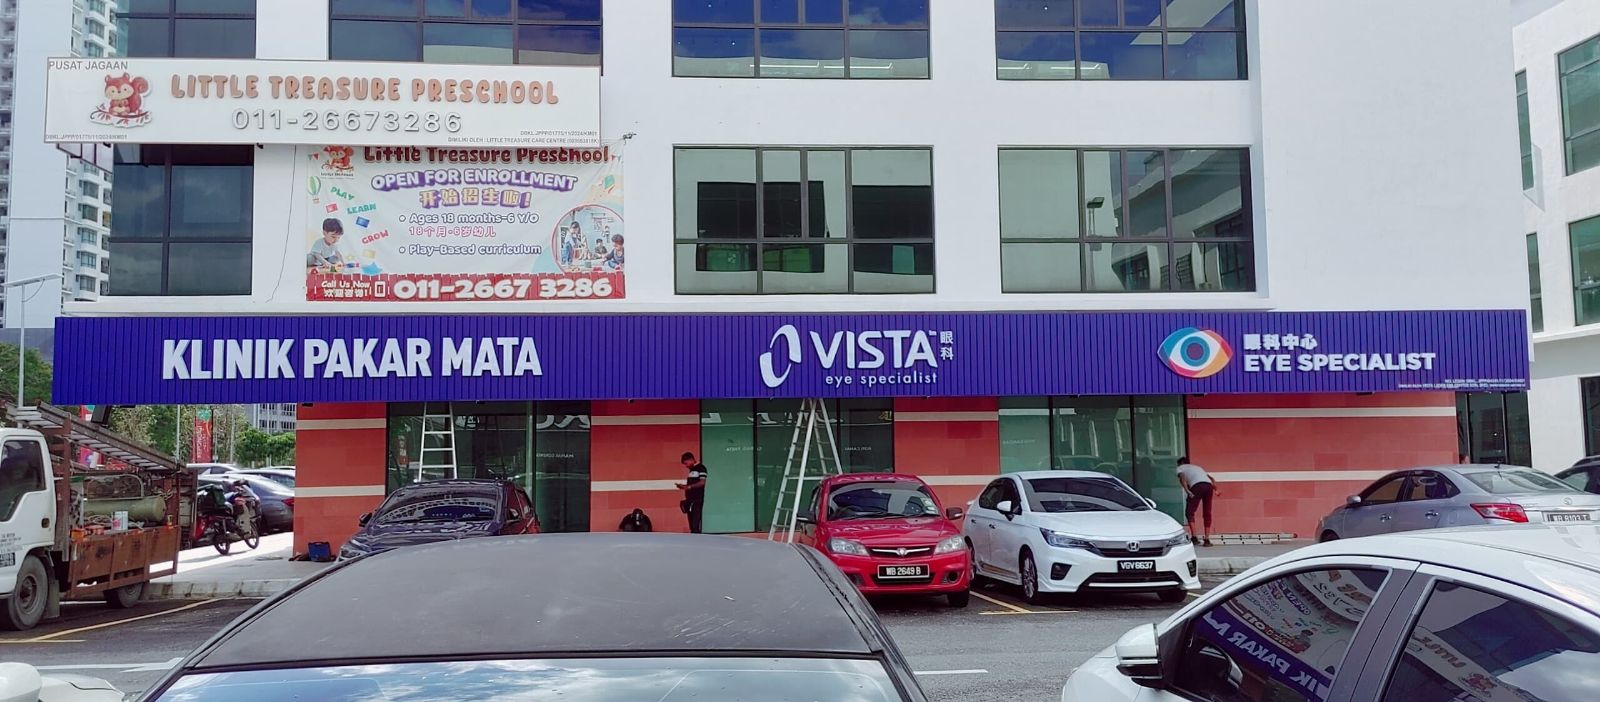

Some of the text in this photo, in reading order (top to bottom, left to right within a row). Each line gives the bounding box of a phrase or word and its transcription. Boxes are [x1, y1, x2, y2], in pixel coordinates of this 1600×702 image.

[49, 61, 128, 70] PUSAT JAGAAN
[171, 74, 559, 105] LITTLE TREASURE PRESCHOOL
[232, 107, 463, 133] 011-26673286
[364, 146, 609, 163] Little Treasure Preschool
[371, 168, 578, 192] OPEN FOR ENROLLMENT
[330, 186, 355, 201] PLAY
[347, 203, 377, 214] LEARN
[409, 213, 540, 226] Ages 18 months-6 Y/O
[361, 230, 389, 244] GROW
[409, 244, 542, 257] Play-Based curriculum
[321, 280, 336, 289] Call
[339, 280, 350, 288] Us
[393, 278, 613, 299] 011-2667 3286
[809, 329, 938, 369] VISTA
[940, 330, 954, 361] 眼科
[1243, 333, 1318, 350] 眼科中心
[163, 336, 543, 380] KLINIK PAKAR MATA
[1243, 352, 1436, 372] EYE SPECIALIST
[825, 370, 938, 388] eye specialist
[885, 566, 922, 576] WB 2649 B
